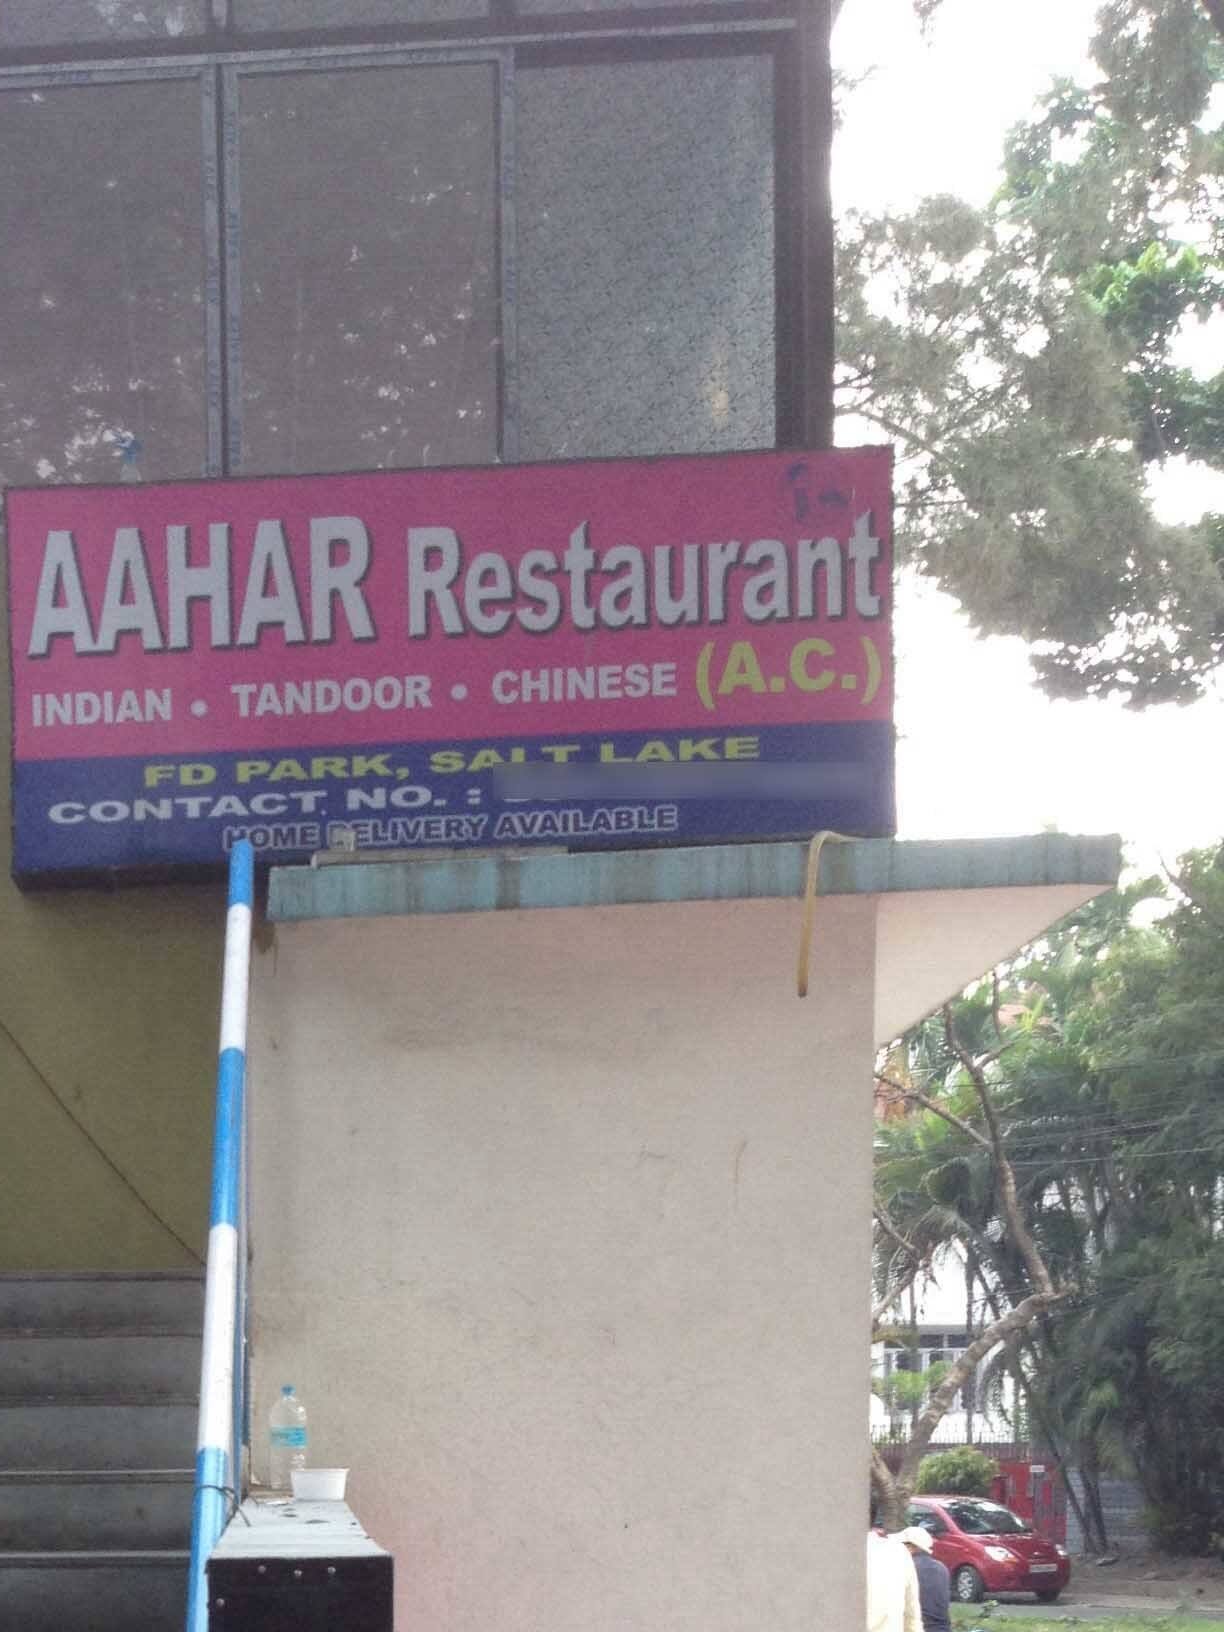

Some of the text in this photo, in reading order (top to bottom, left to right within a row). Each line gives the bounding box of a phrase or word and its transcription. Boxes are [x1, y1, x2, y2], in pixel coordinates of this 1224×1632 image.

[28, 510, 881, 659] AAHAR Restaurant
[32, 636, 882, 727] INDIAN TANDOOR CHINESE (A.C.)
[143, 763, 217, 788] FD
[236, 753, 410, 781] PARK,
[600, 736, 761, 763] LAKE
[47, 789, 328, 824] CONTACT
[346, 784, 447, 811] NO.
[494, 804, 678, 839] AVAILABLE
